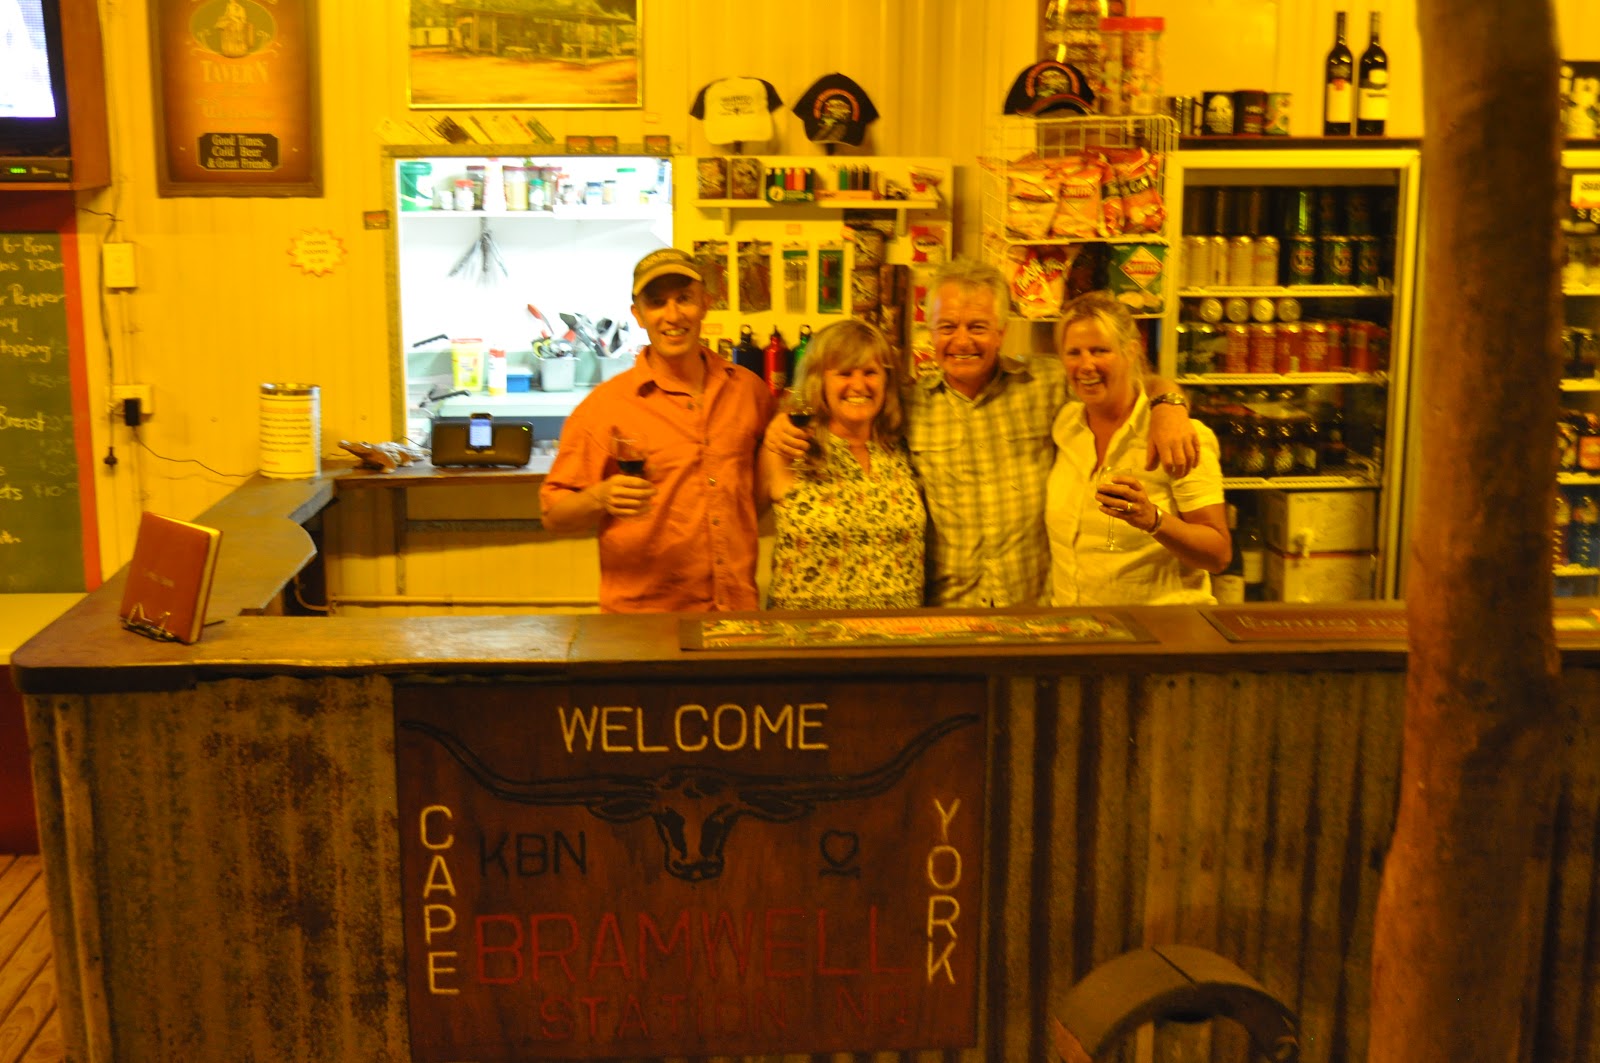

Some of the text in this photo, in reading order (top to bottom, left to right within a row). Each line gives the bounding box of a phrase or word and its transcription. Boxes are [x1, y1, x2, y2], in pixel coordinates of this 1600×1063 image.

[201, 60, 269, 83] TAVERN
[211, 134, 236, 146] Good
[211, 146, 263, 158] Cold Beer
[216, 158, 239, 169] Great
[558, 702, 828, 754] WELCOME
[478, 830, 588, 878] KBN
[419, 804, 461, 996] CAPE
[927, 798, 962, 985] YORK
[474, 905, 913, 985] BRAMWELL
[539, 992, 788, 1041] STATION
